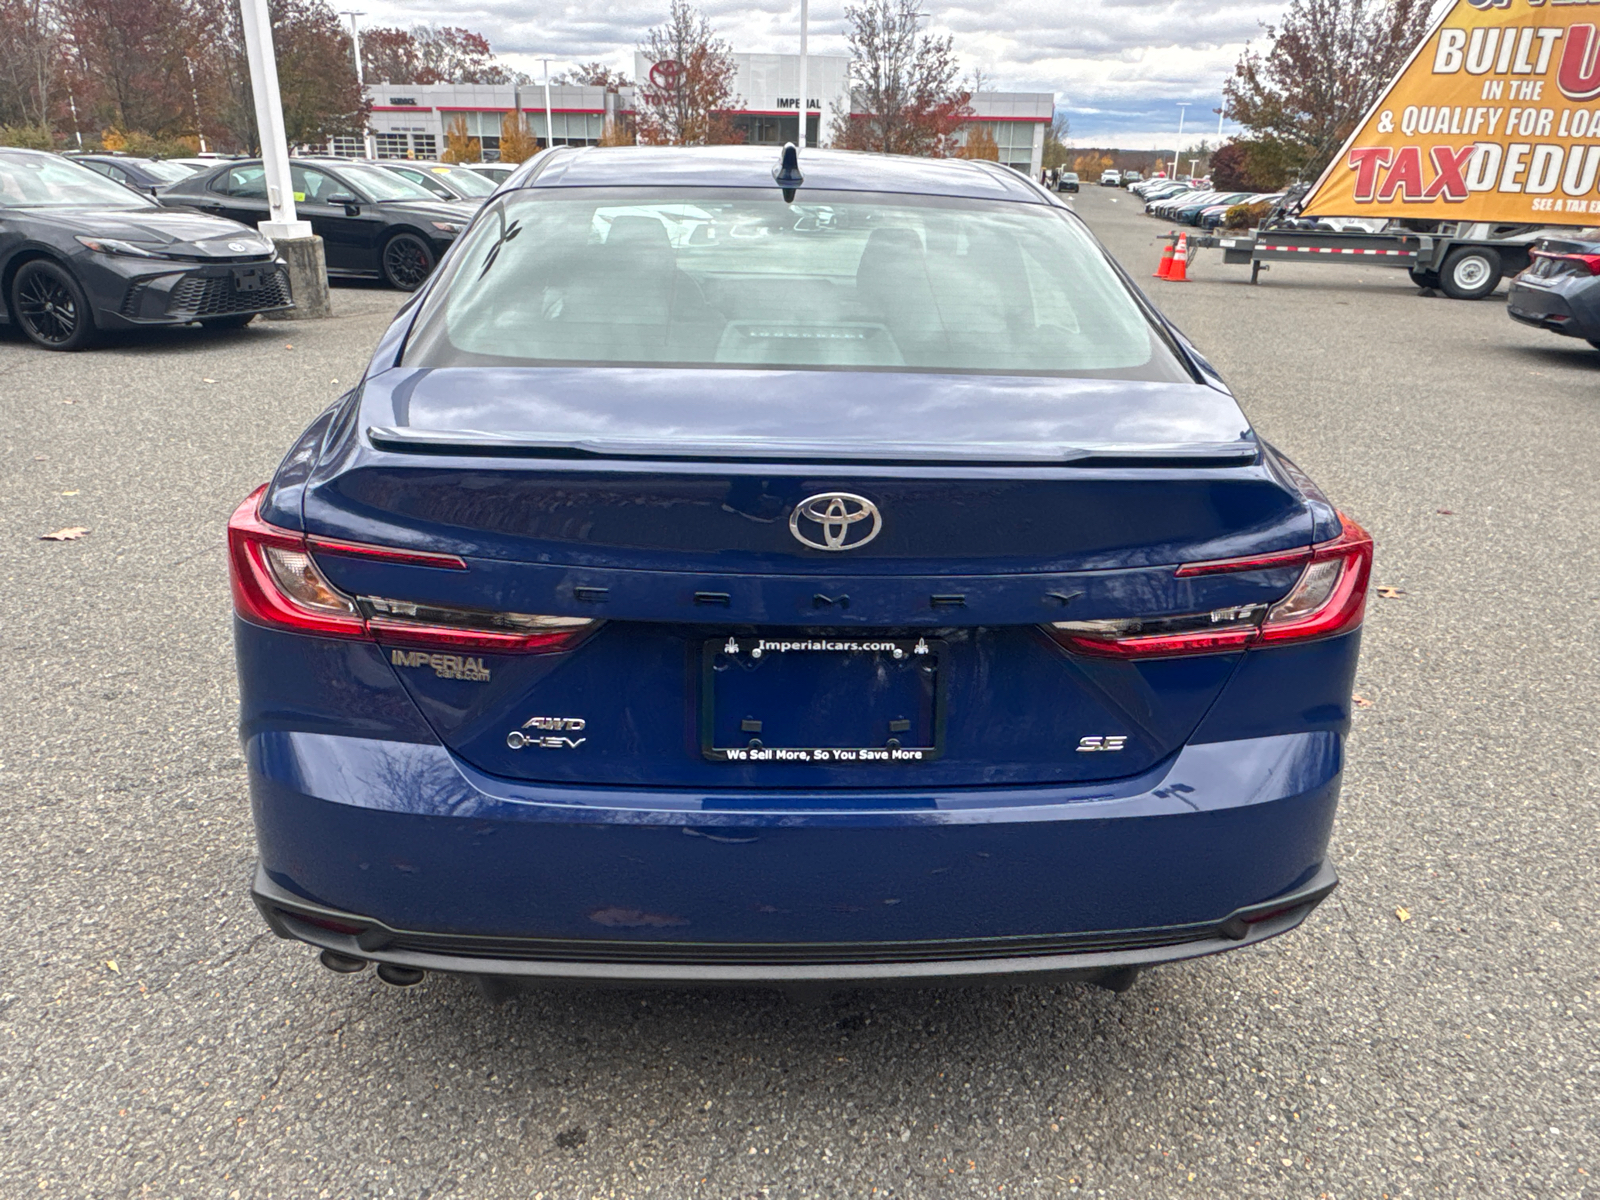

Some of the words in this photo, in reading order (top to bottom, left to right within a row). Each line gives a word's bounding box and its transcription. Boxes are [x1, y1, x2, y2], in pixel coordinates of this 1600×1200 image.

[1432, 27, 1563, 75] BUILT
[1481, 80, 1503, 100] IN
[1508, 80, 1545, 101] THE
[643, 94, 699, 107] TOY
[777, 98, 821, 109] IMPEIAL
[1377, 110, 1395, 134] &
[1401, 106, 1503, 137] QUALIFY
[1505, 107, 1554, 137] FOR
[1348, 146, 1479, 203] TAX
[1466, 142, 1600, 196] DEDU
[1531, 198, 1554, 211] SEE
[1554, 199, 1563, 212] A
[1565, 199, 1588, 212] TAX
[758, 639, 896, 652] Imperialcars.com
[391, 650, 490, 674] IMPERIAL
[436, 669, 490, 682] cars.com
[521, 717, 586, 731] AWD
[523, 735, 587, 749] HEV
[1076, 735, 1127, 751] SE
[726, 749, 746, 760] We
[749, 749, 772, 760] Sell
[776, 749, 811, 762] More,
[813, 749, 829, 760] So
[832, 749, 855, 760] You
[859, 749, 888, 760] Save
[892, 749, 922, 760] More
